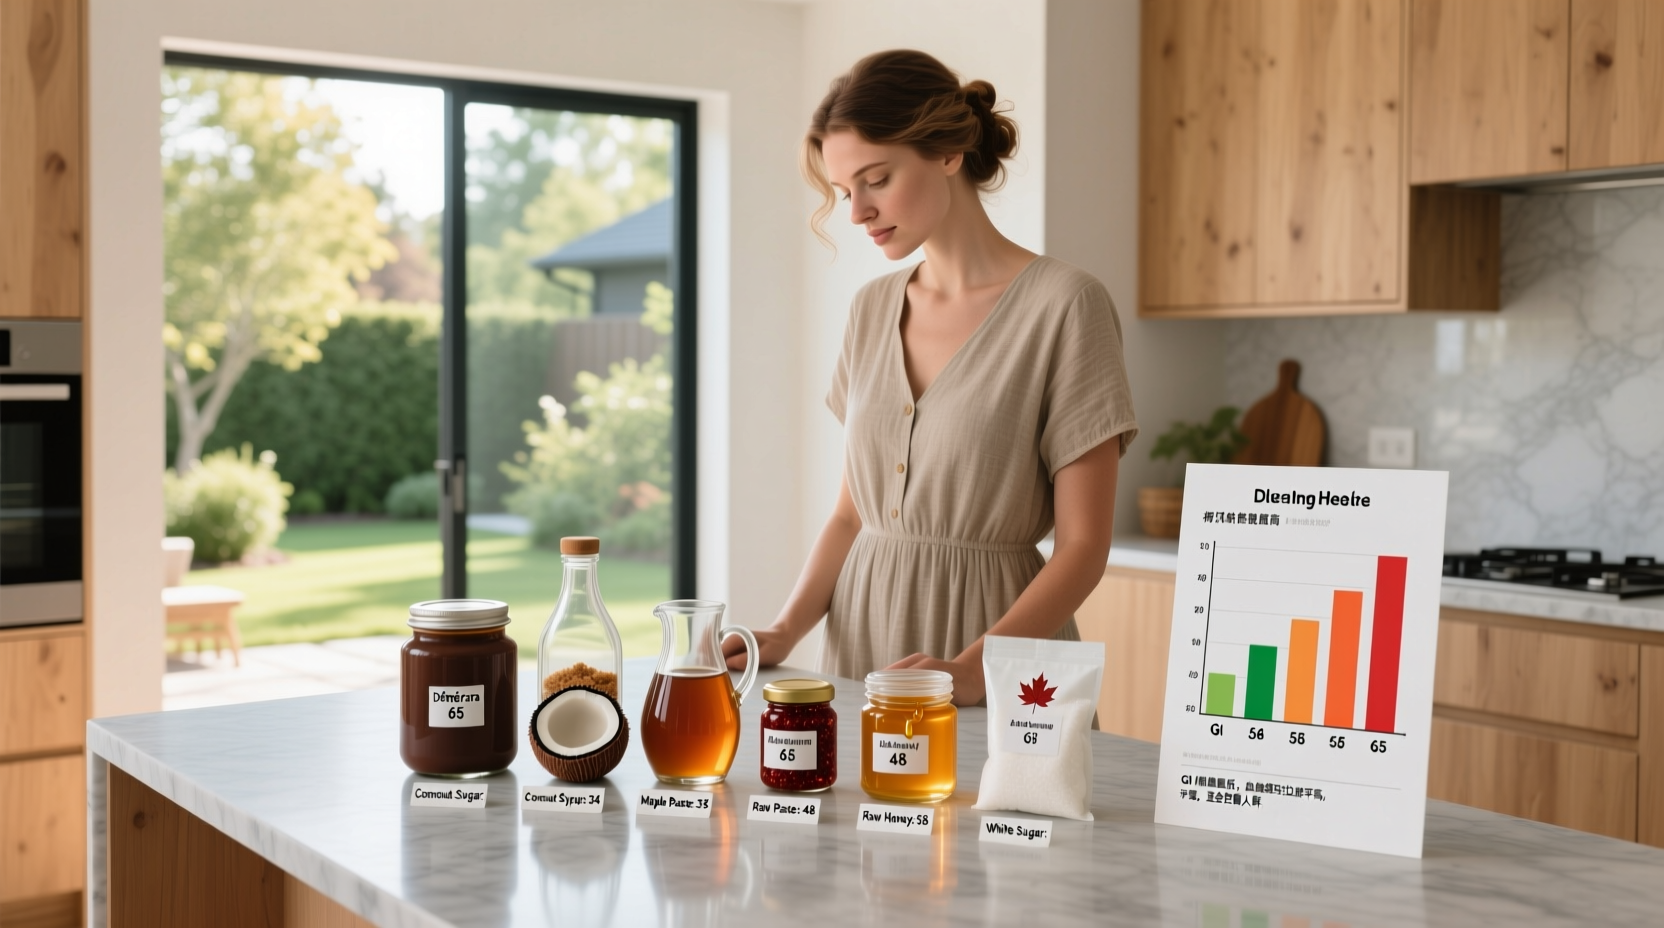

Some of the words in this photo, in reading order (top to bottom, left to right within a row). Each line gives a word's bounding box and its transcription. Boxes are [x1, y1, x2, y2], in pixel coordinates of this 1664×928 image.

[448, 706, 464, 720] 65
[1370, 740, 1387, 753] 65
[779, 748, 796, 762] 65
[889, 752, 907, 766] 48
[752, 801, 771, 812] Raw
[802, 805, 816, 815] 48
[862, 810, 881, 822] Raw
[916, 814, 929, 826] 58
